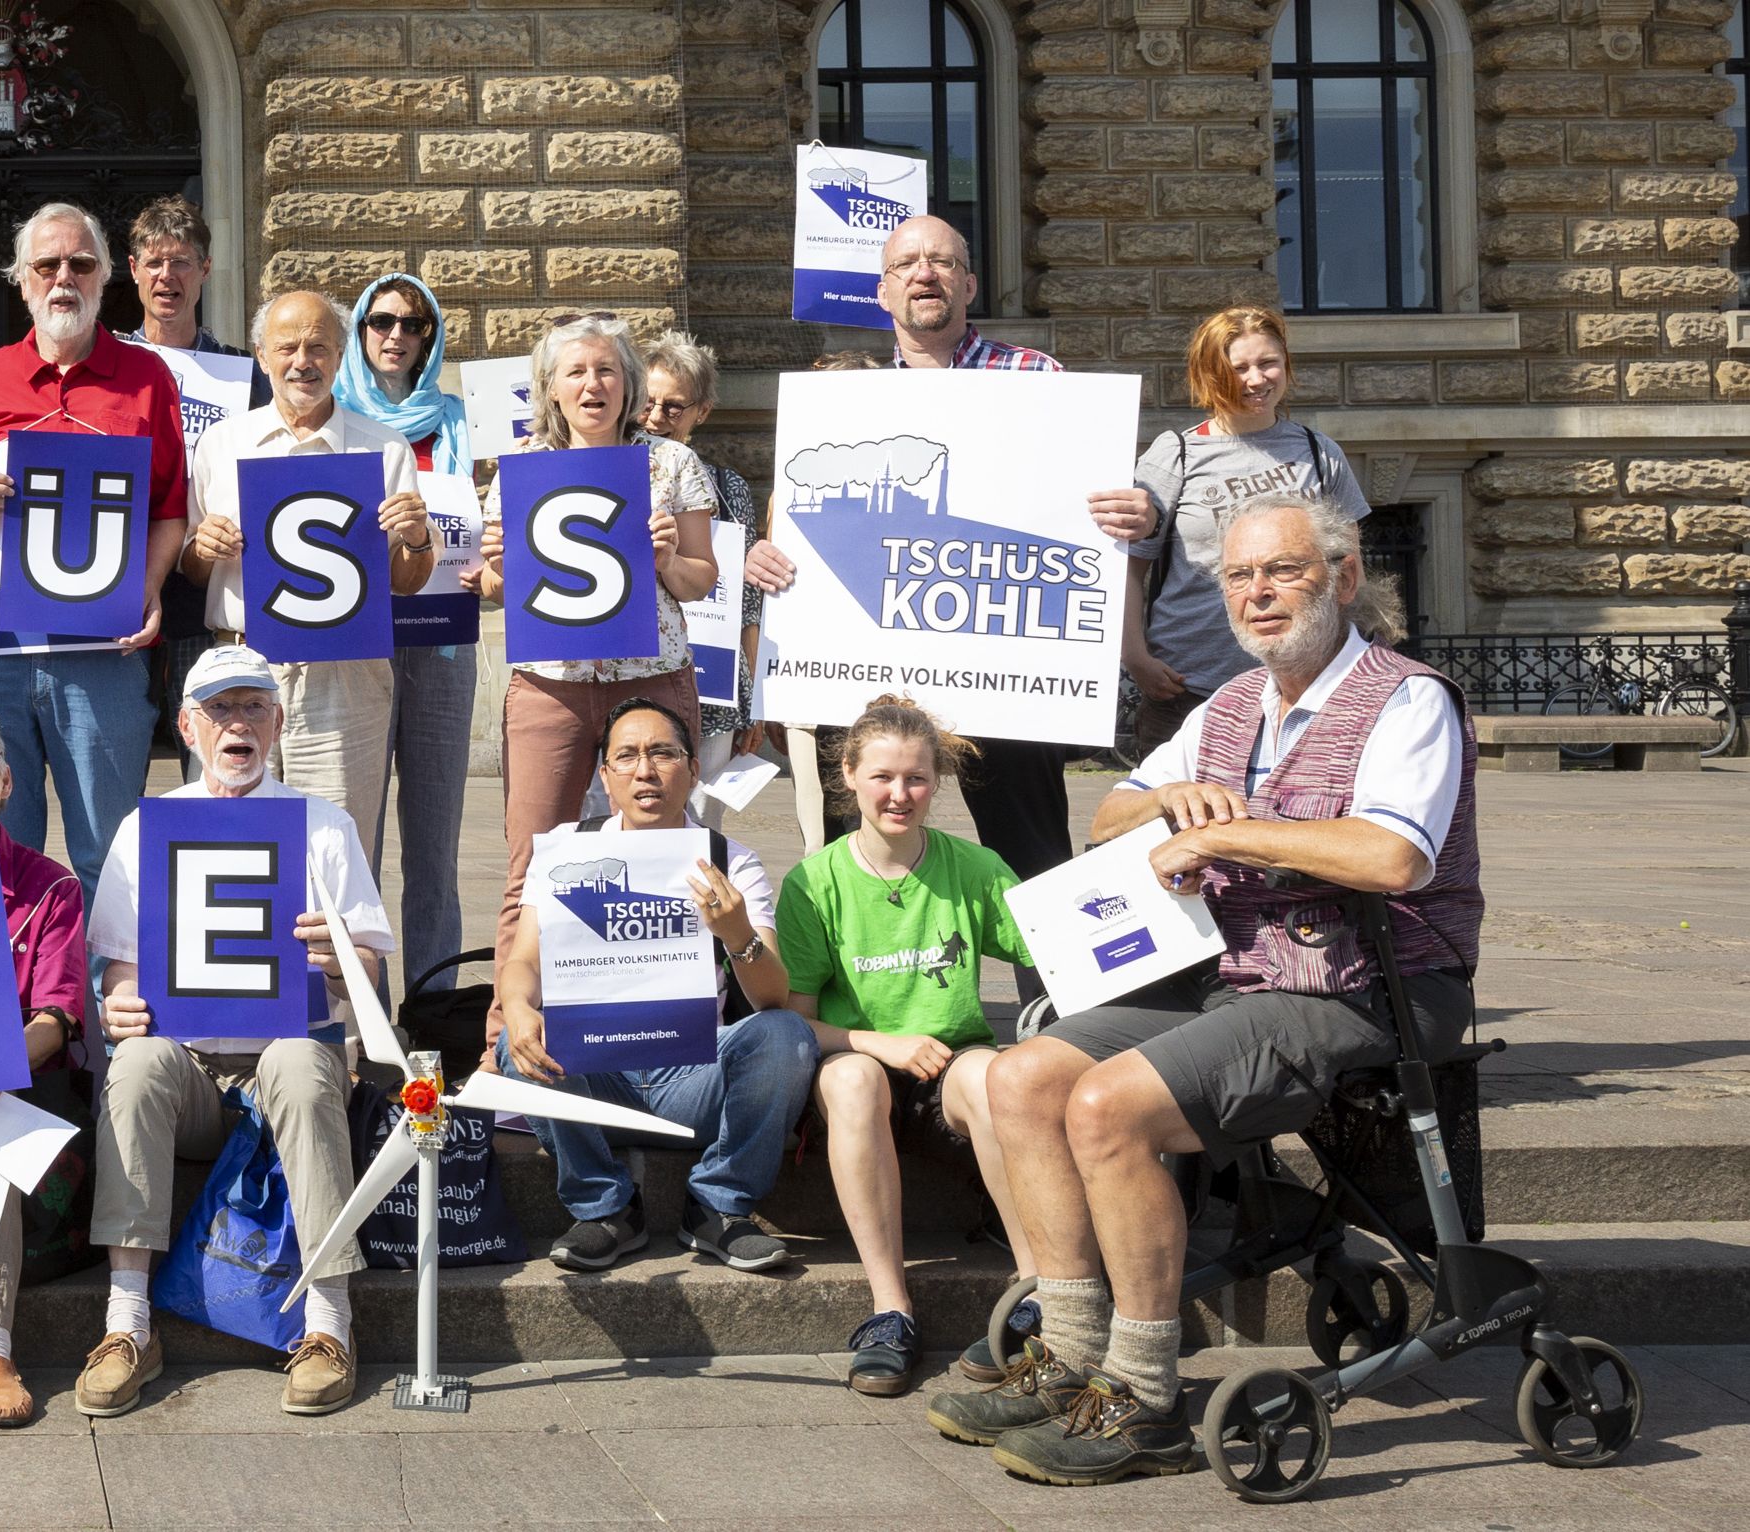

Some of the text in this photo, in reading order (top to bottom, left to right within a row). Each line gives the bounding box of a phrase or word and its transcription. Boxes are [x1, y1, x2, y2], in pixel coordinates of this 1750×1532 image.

[847, 199, 915, 218] TSCHÜSS
[848, 211, 900, 231] KOHL
[806, 235, 855, 245] HAMBURGER
[823, 291, 880, 305] Hier unterschre
[180, 402, 230, 420] CHÜSS
[1225, 461, 1298, 499] FIGHT
[881, 537, 1102, 586] TSCHÜSS
[394, 615, 451, 625] unterschreiben.
[685, 610, 726, 622] SINITIATIVE
[880, 578, 1107, 643] KOHLE
[767, 659, 1099, 699] HAMBURGER VOLKSINITIATIVE
[603, 900, 698, 919] TSCHÜSS
[605, 916, 699, 942] KOHLE
[554, 951, 700, 968] HAMBURGER VOLKSINITIATIVE
[555, 967, 645, 979] www.tschuess-kohle.de
[583, 1029, 680, 1044] Hier unterschreiben.
[1466, 1304, 1533, 1340] TOPRO TROJA
